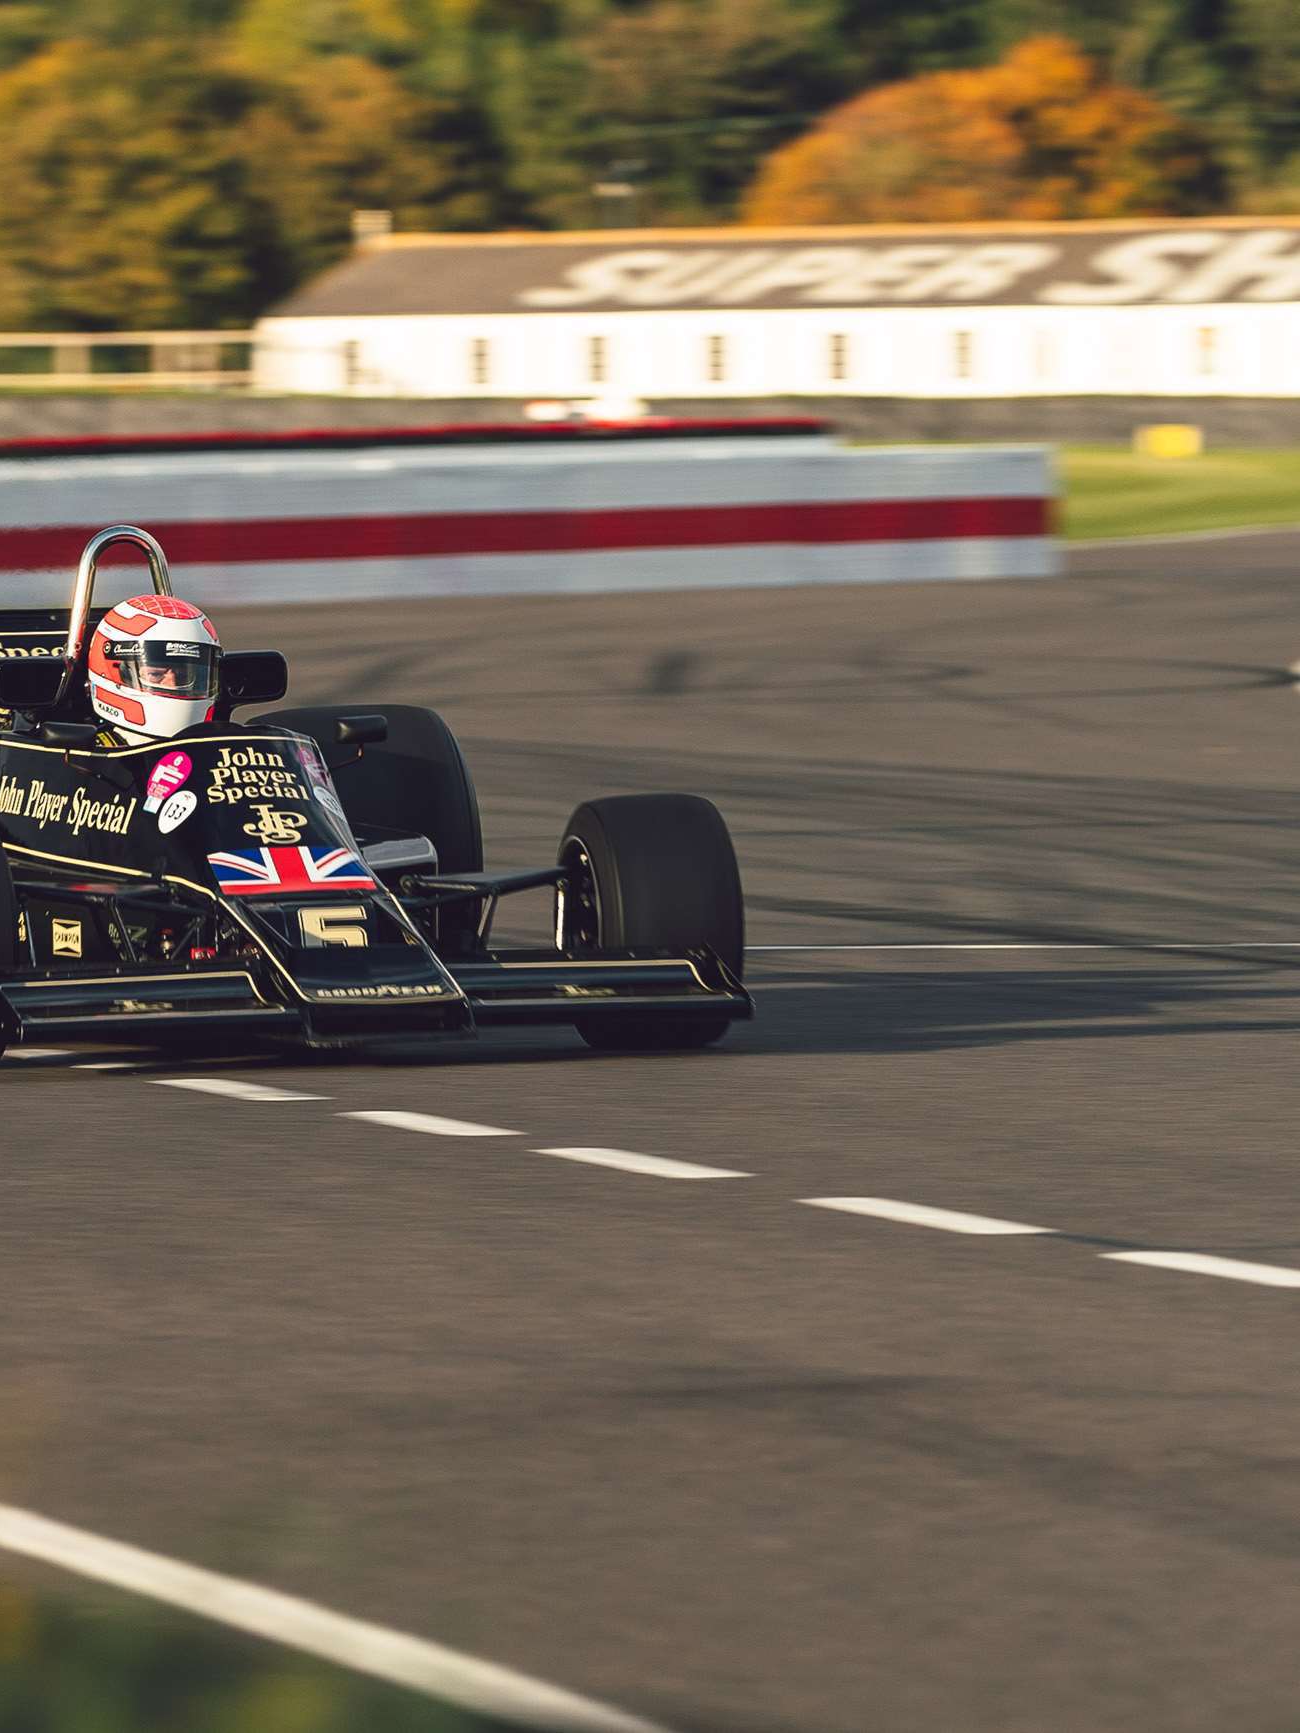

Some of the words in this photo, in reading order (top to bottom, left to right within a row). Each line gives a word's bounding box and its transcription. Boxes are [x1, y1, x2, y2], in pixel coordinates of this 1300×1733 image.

[522, 244, 1060, 306] SUPER
[217, 747, 285, 768] John
[210, 766, 298, 786] Player
[206, 781, 310, 804] Special
[24, 779, 69, 830] Player
[66, 787, 137, 836] Special
[164, 803, 187, 820] 133
